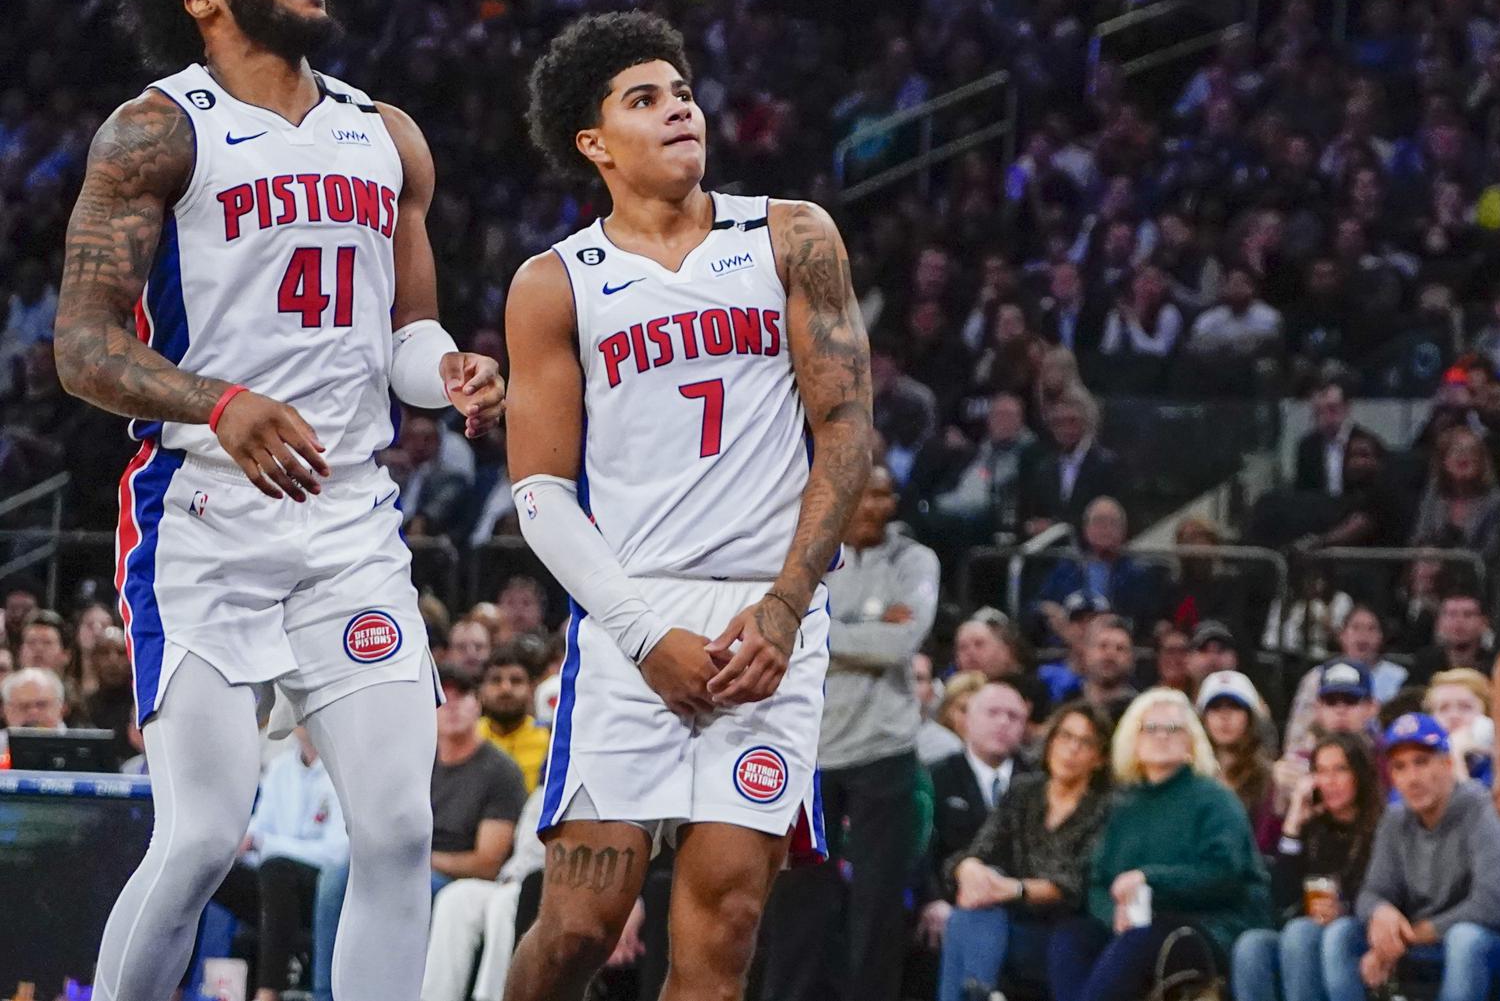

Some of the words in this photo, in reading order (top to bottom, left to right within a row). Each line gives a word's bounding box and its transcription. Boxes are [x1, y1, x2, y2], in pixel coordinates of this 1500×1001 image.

[196, 91, 211, 110] 6
[331, 128, 371, 143] UWM
[216, 173, 396, 242] PISTONS
[584, 248, 601, 266] 6
[710, 252, 753, 273] UWM
[277, 246, 357, 328] 41
[598, 306, 780, 389] PISTONS
[678, 377, 725, 458] 7
[354, 626, 390, 640] DETROIT
[355, 635, 392, 650] PISTONS
[746, 761, 780, 778] DETROIT
[743, 771, 779, 789] PISTONS
